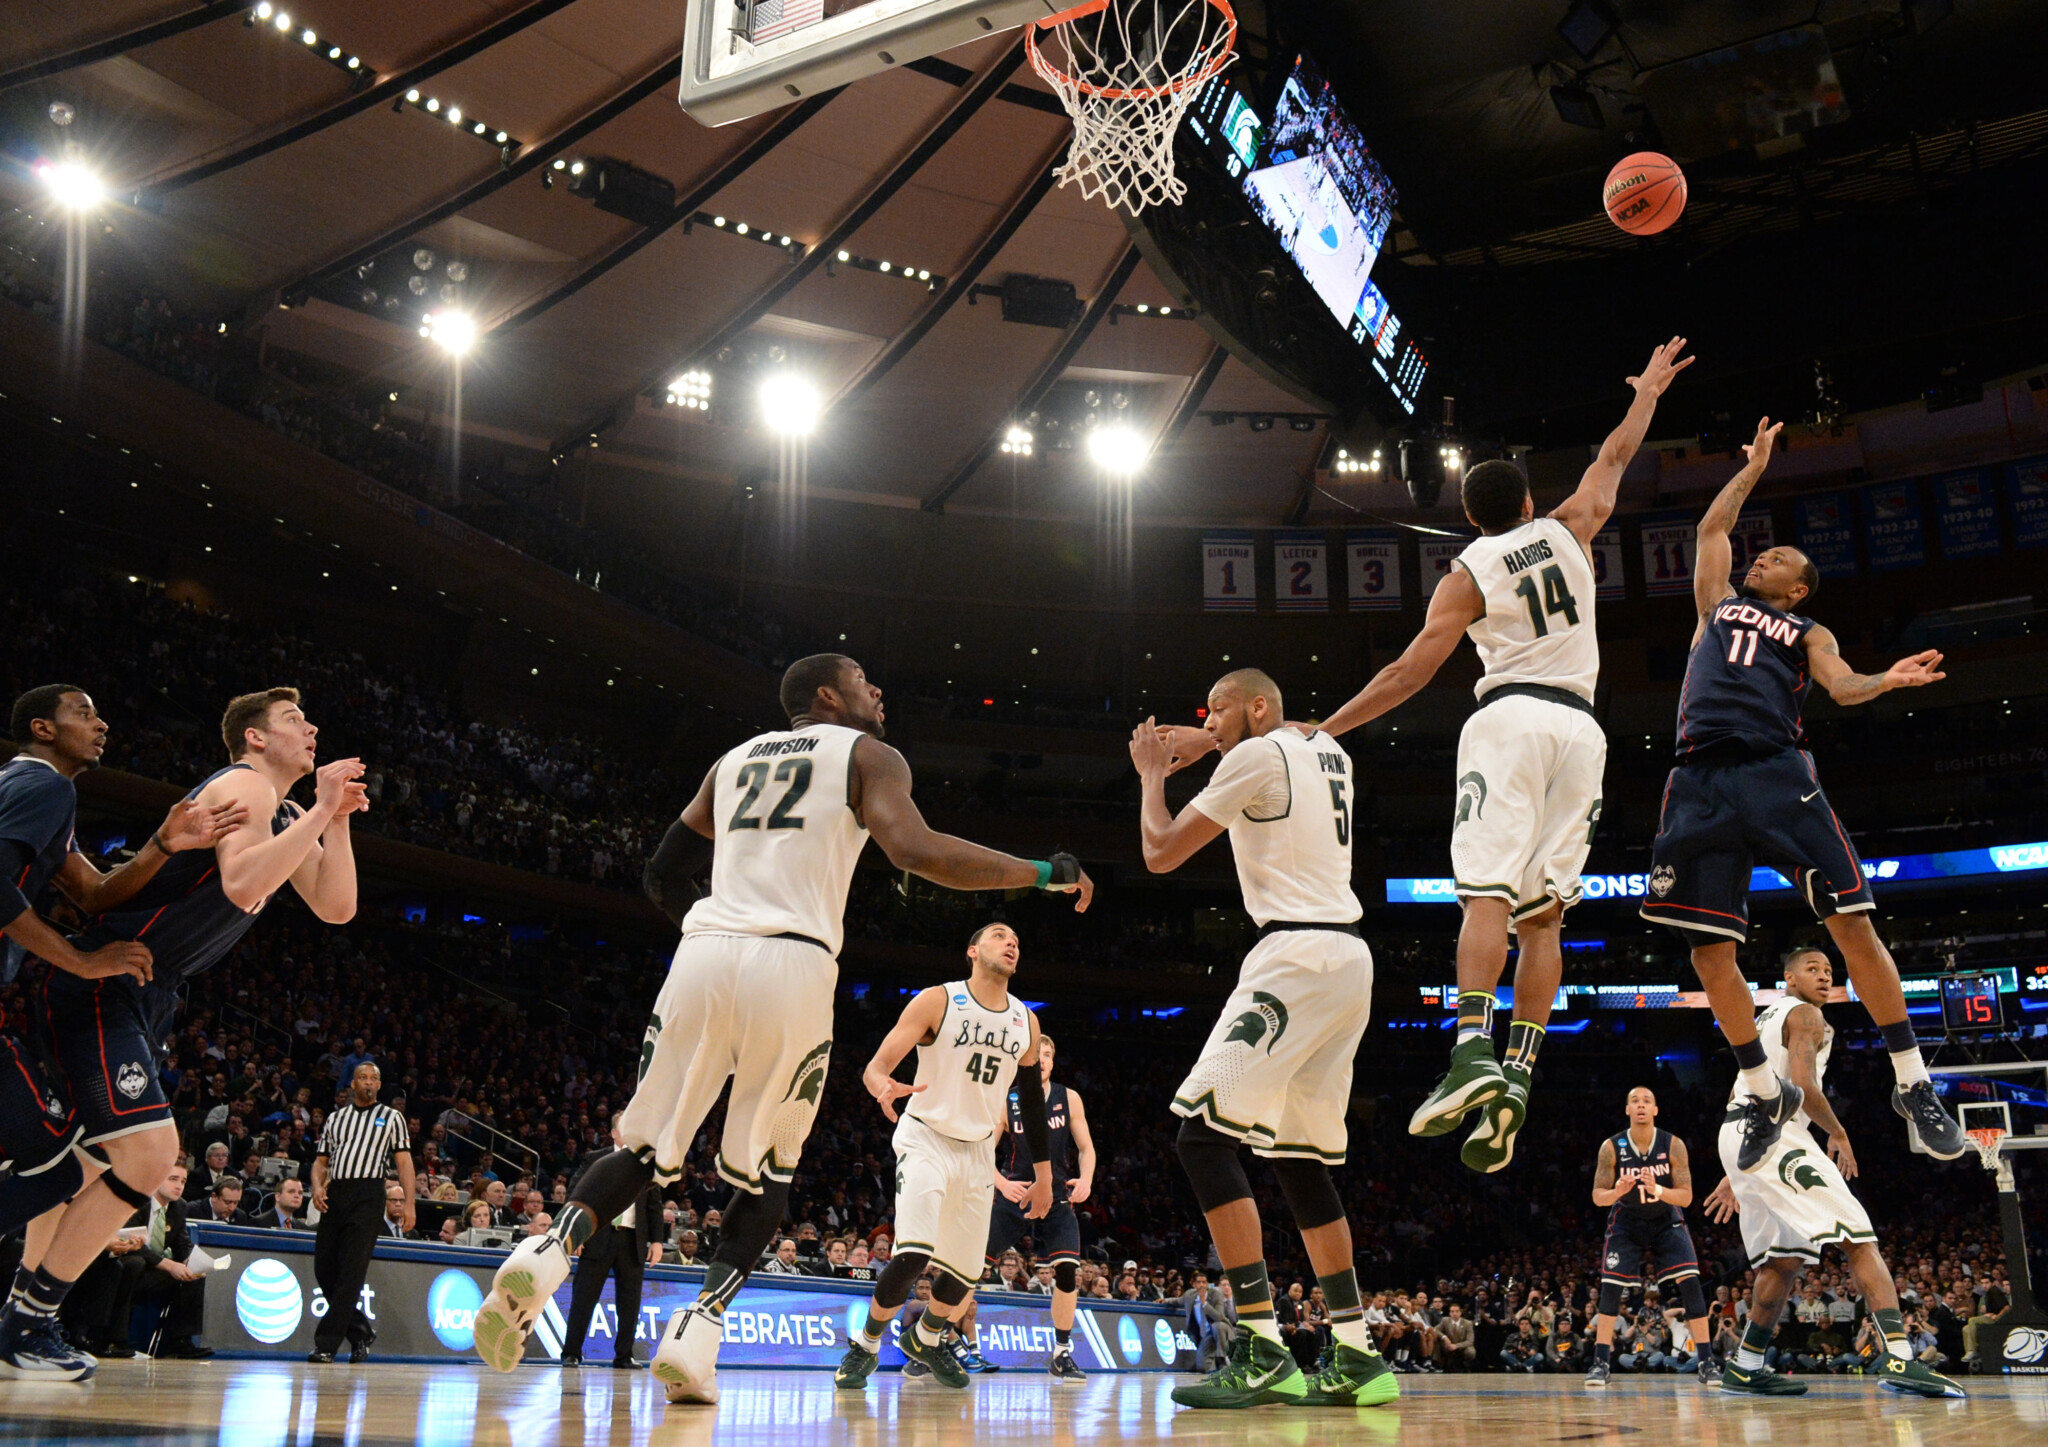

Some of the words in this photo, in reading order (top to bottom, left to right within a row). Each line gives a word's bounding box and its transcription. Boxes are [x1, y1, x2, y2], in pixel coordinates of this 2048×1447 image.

[1226, 153, 1241, 177] 19
[1615, 197, 1651, 222] NCAA
[1352, 322, 1366, 344] 21
[1943, 506, 1994, 524] 1939-40
[1649, 529, 1688, 542] MESSIER
[1869, 519, 1919, 536] 1932-33
[1283, 548, 1318, 558] LEETCH
[1503, 538, 1554, 575] HARRIS
[1653, 542, 1689, 579] 11
[1221, 561, 1237, 594] 1
[1290, 561, 1312, 595] 2
[1363, 560, 1385, 594] 3
[1513, 562, 1583, 640] 14
[1728, 629, 1759, 668] 11
[746, 737, 820, 760] DAWSON
[1935, 752, 2022, 772] EIGHTEEN
[2028, 748, 2047, 762] 76
[727, 756, 814, 834] 22
[1328, 778, 1349, 847] 5
[1412, 879, 1456, 895] NCA
[1419, 986, 1442, 997] TIME
[1597, 985, 1638, 995] OFFENSIVE
[1638, 984, 1679, 994] REBOUNDS
[1634, 994, 1646, 1008] 2
[1965, 995, 1992, 1022] 15
[954, 1020, 1020, 1060] State
[965, 1052, 1002, 1086] 45
[852, 1268, 871, 1280] POSS
